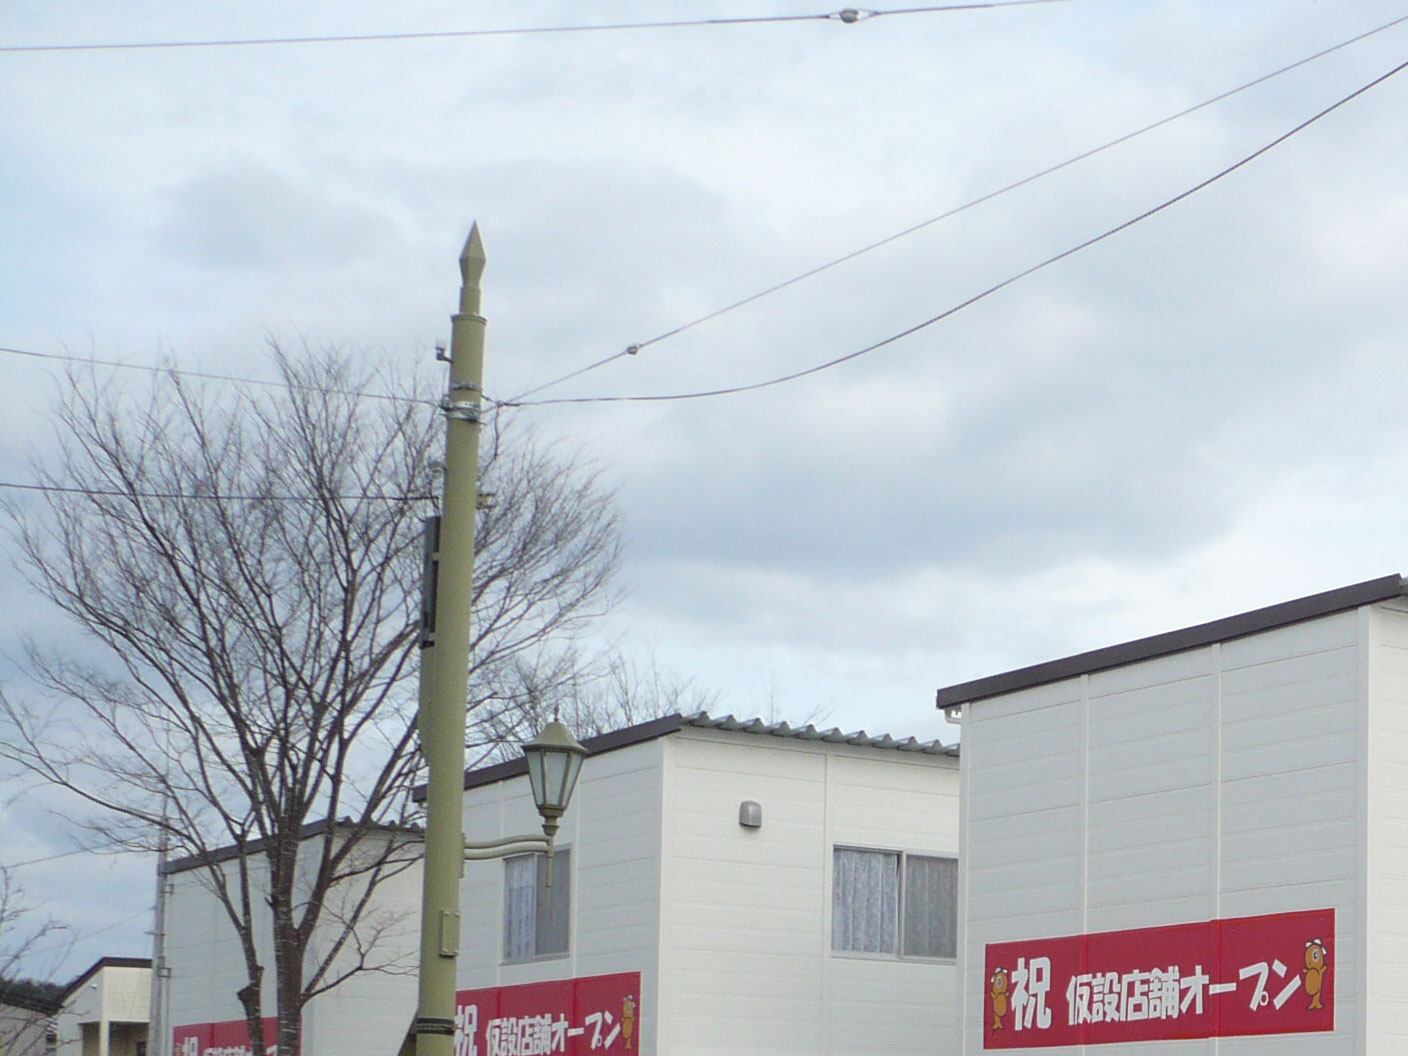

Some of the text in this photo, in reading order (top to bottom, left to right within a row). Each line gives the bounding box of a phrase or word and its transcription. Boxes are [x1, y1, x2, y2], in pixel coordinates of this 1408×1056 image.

[1010, 956, 1301, 1031] 祝 仮設店舗オープン
